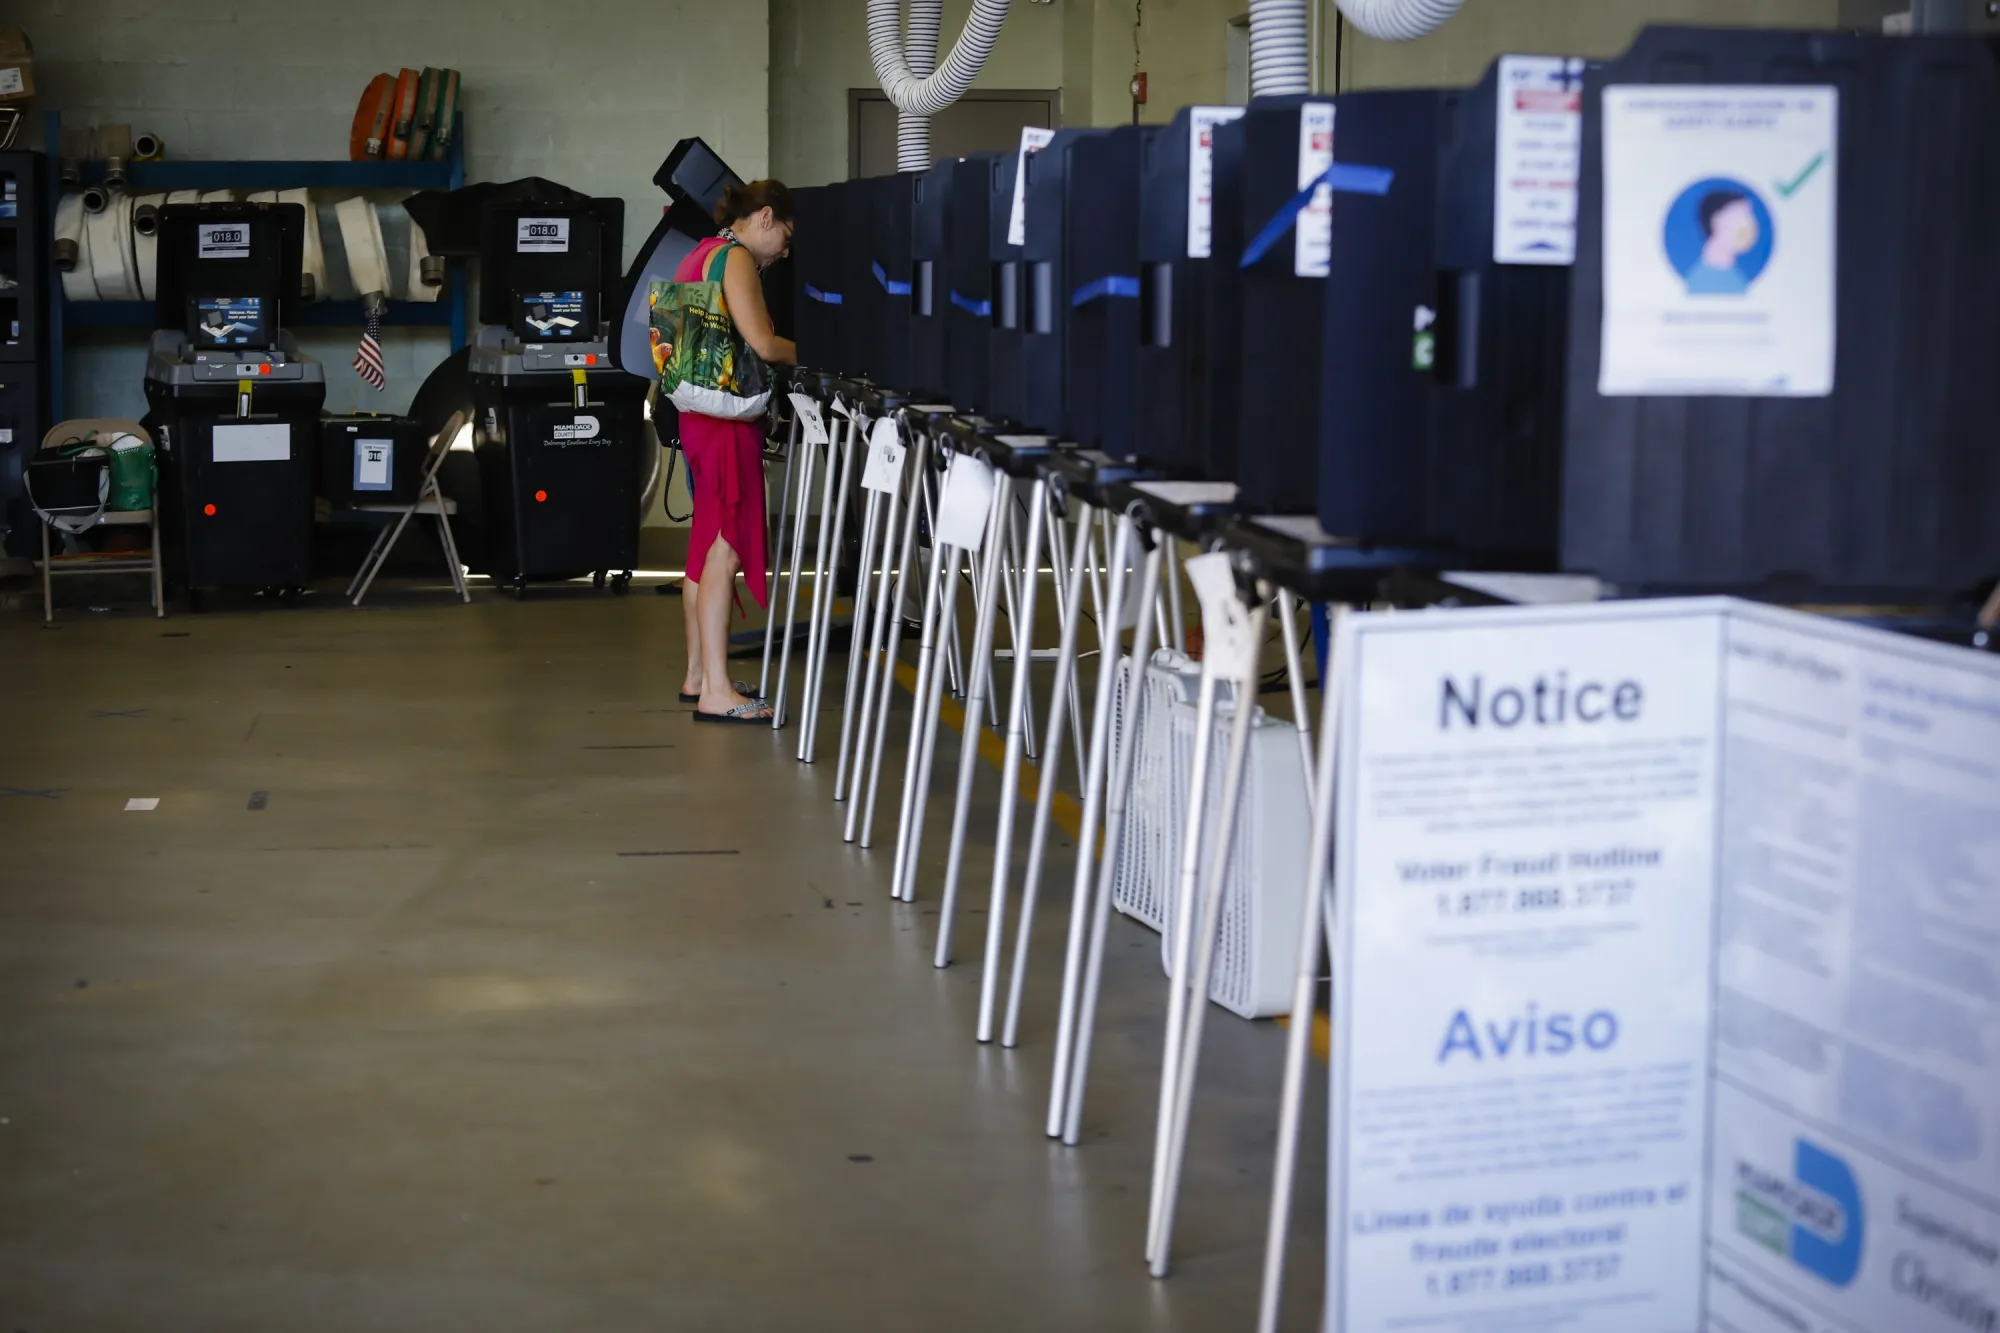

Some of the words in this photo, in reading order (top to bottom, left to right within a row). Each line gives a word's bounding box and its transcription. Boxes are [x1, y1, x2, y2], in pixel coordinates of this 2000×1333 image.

[213, 232, 241, 242] 018.0
[530, 226, 557, 235] 018.0
[368, 452, 382, 460] 018
[1436, 668, 1646, 732] Notice
[1478, 850, 1562, 876] Fraud
[1567, 844, 1664, 870] Hotline
[1434, 999, 1623, 1068] Aviso
